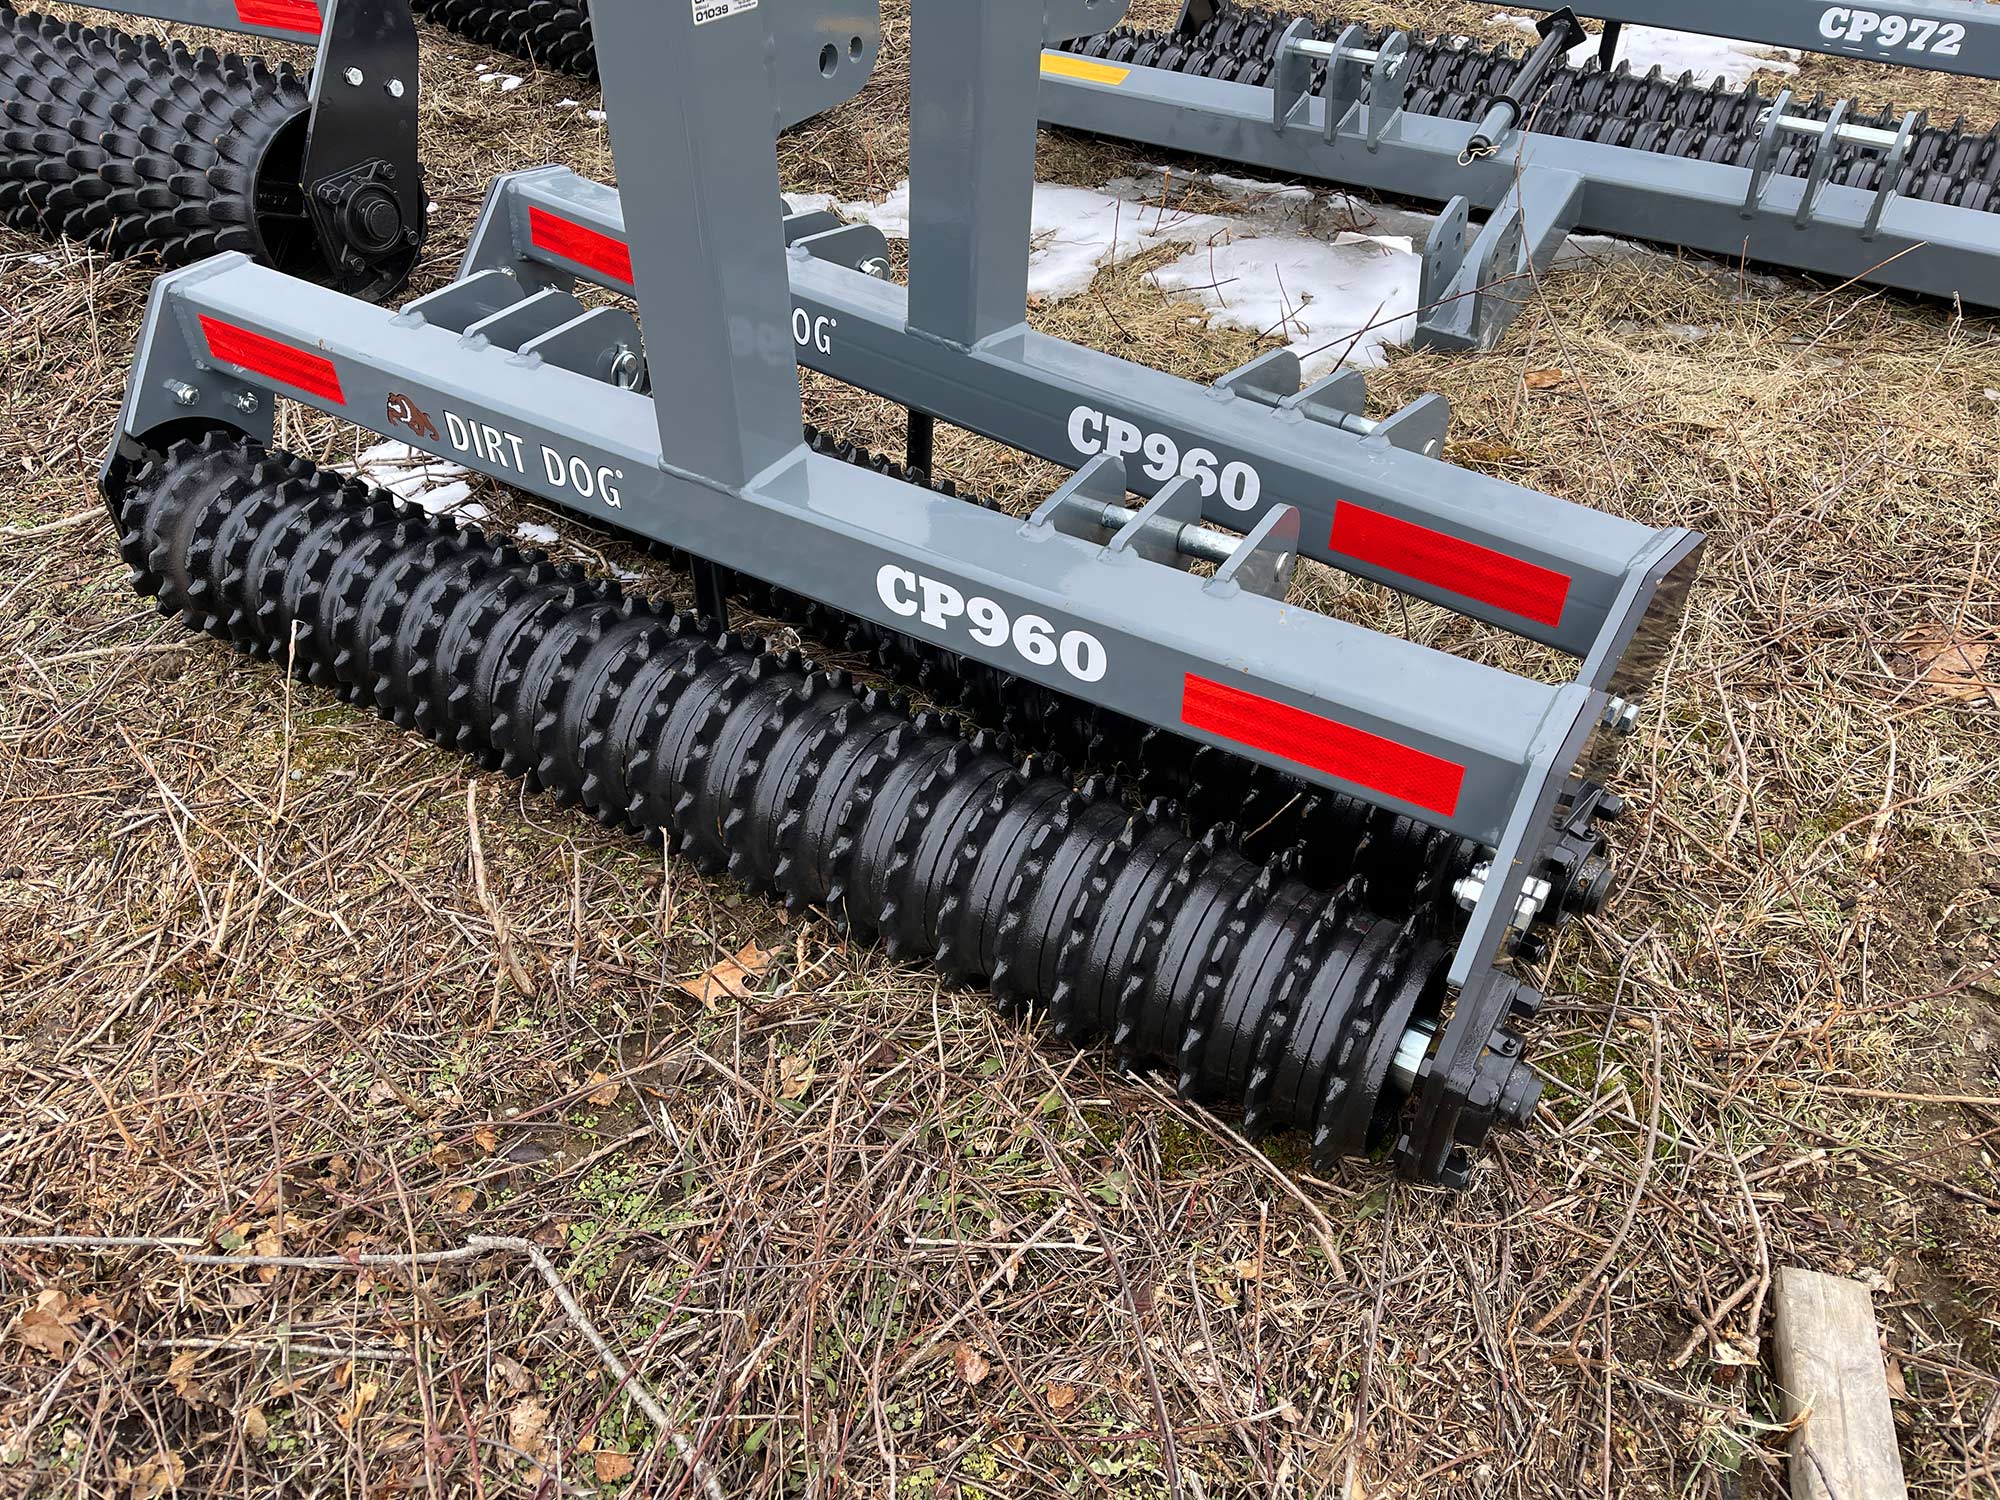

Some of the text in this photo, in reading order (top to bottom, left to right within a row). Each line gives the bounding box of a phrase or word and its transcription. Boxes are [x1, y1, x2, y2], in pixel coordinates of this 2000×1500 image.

[695, 4, 729, 22] 01039
[1819, 6, 1966, 56] CP972
[792, 307, 833, 355] OG
[443, 409, 623, 511] DIRT DOG
[1067, 405, 1261, 511] CP960
[876, 564, 1107, 683] CP960
